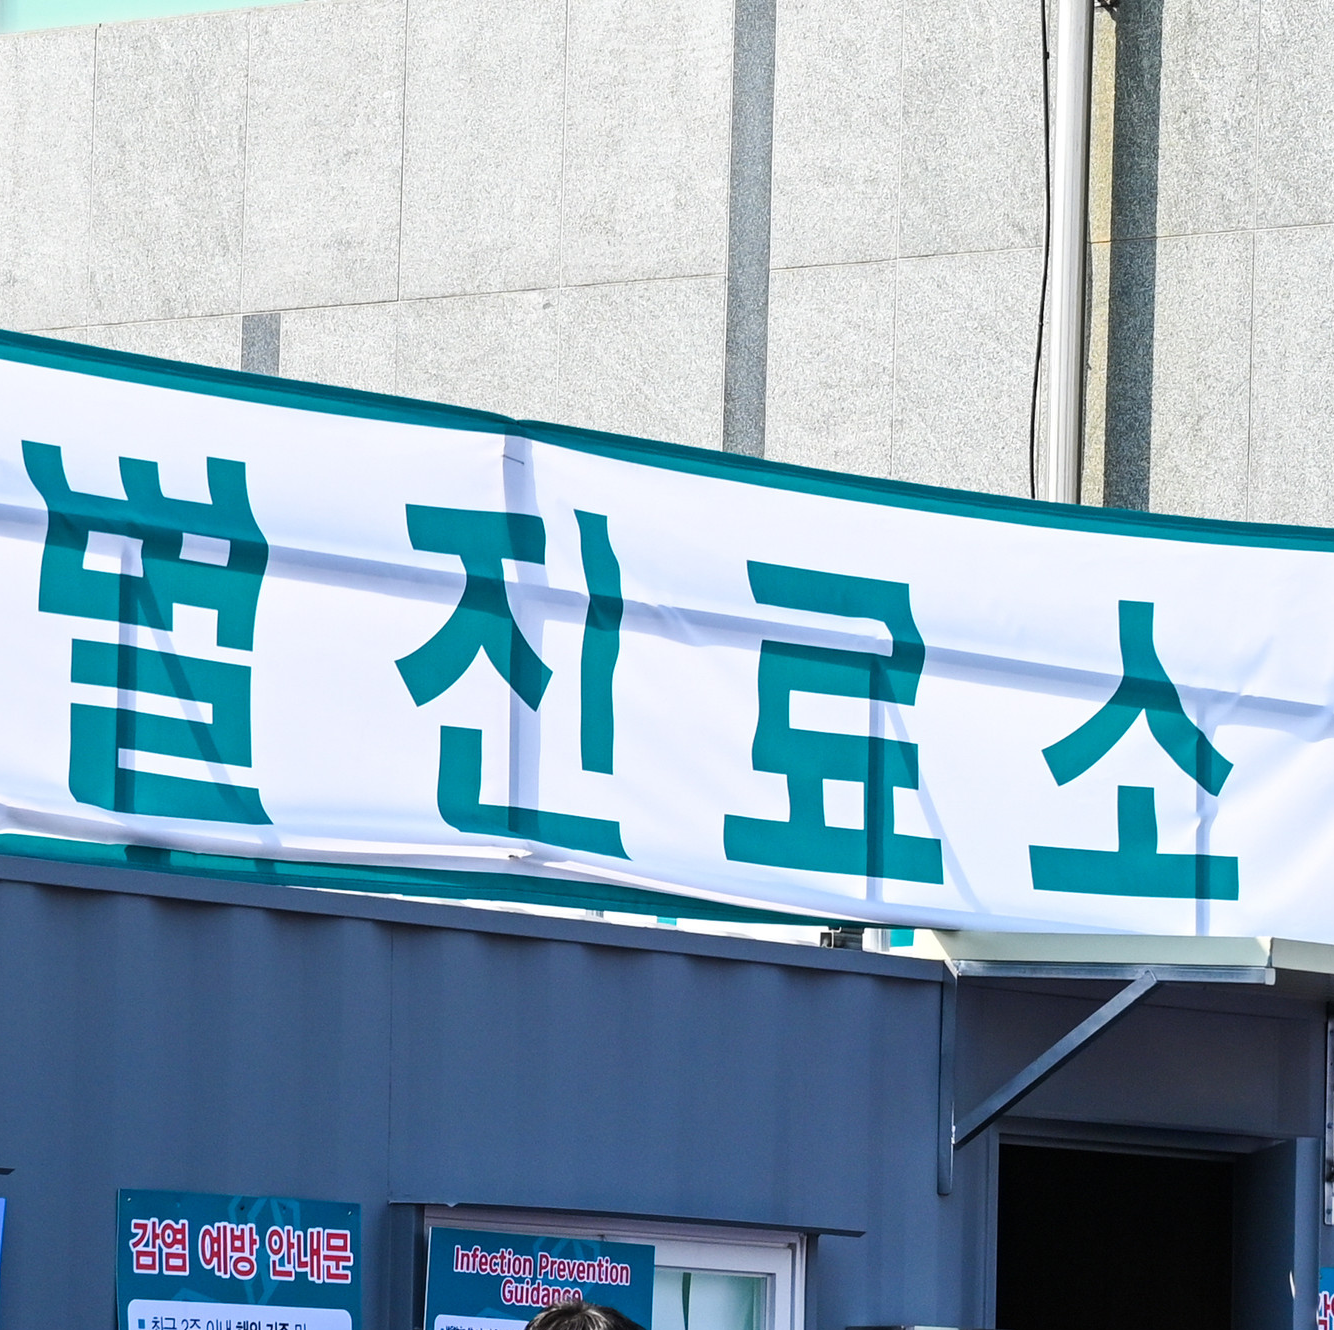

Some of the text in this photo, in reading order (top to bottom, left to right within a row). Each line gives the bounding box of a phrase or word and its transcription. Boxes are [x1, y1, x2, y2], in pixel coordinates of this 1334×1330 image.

[130, 1217, 353, 1284] 감염 예방 안내문
[454, 1245, 631, 1285] Infection Prevention
[501, 1278, 583, 1307] Guidance
